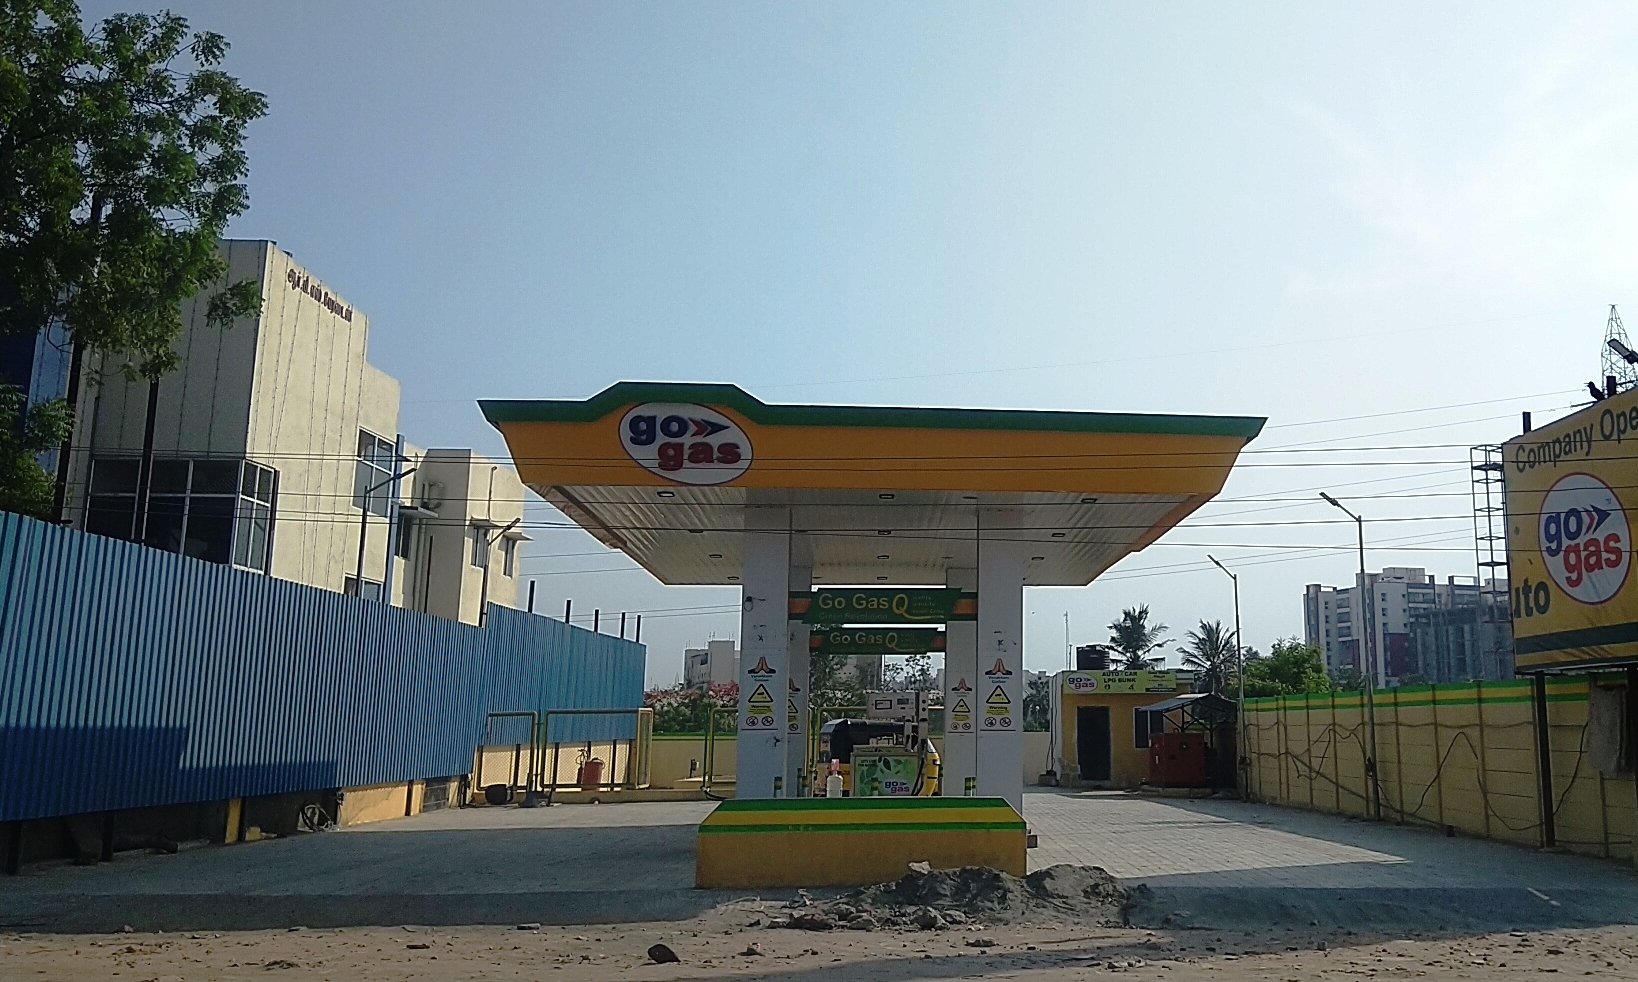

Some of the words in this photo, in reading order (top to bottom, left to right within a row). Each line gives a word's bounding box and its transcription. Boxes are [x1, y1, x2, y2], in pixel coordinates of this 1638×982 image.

[629, 415, 688, 446] go
[658, 441, 742, 471] gas
[1516, 423, 1594, 474] Company
[1544, 507, 1583, 558] go
[1563, 532, 1623, 588] gas
[818, 593, 846, 609] Go
[852, 593, 889, 609] Gas
[829, 632, 851, 644] Go
[855, 632, 883, 644] Gas
